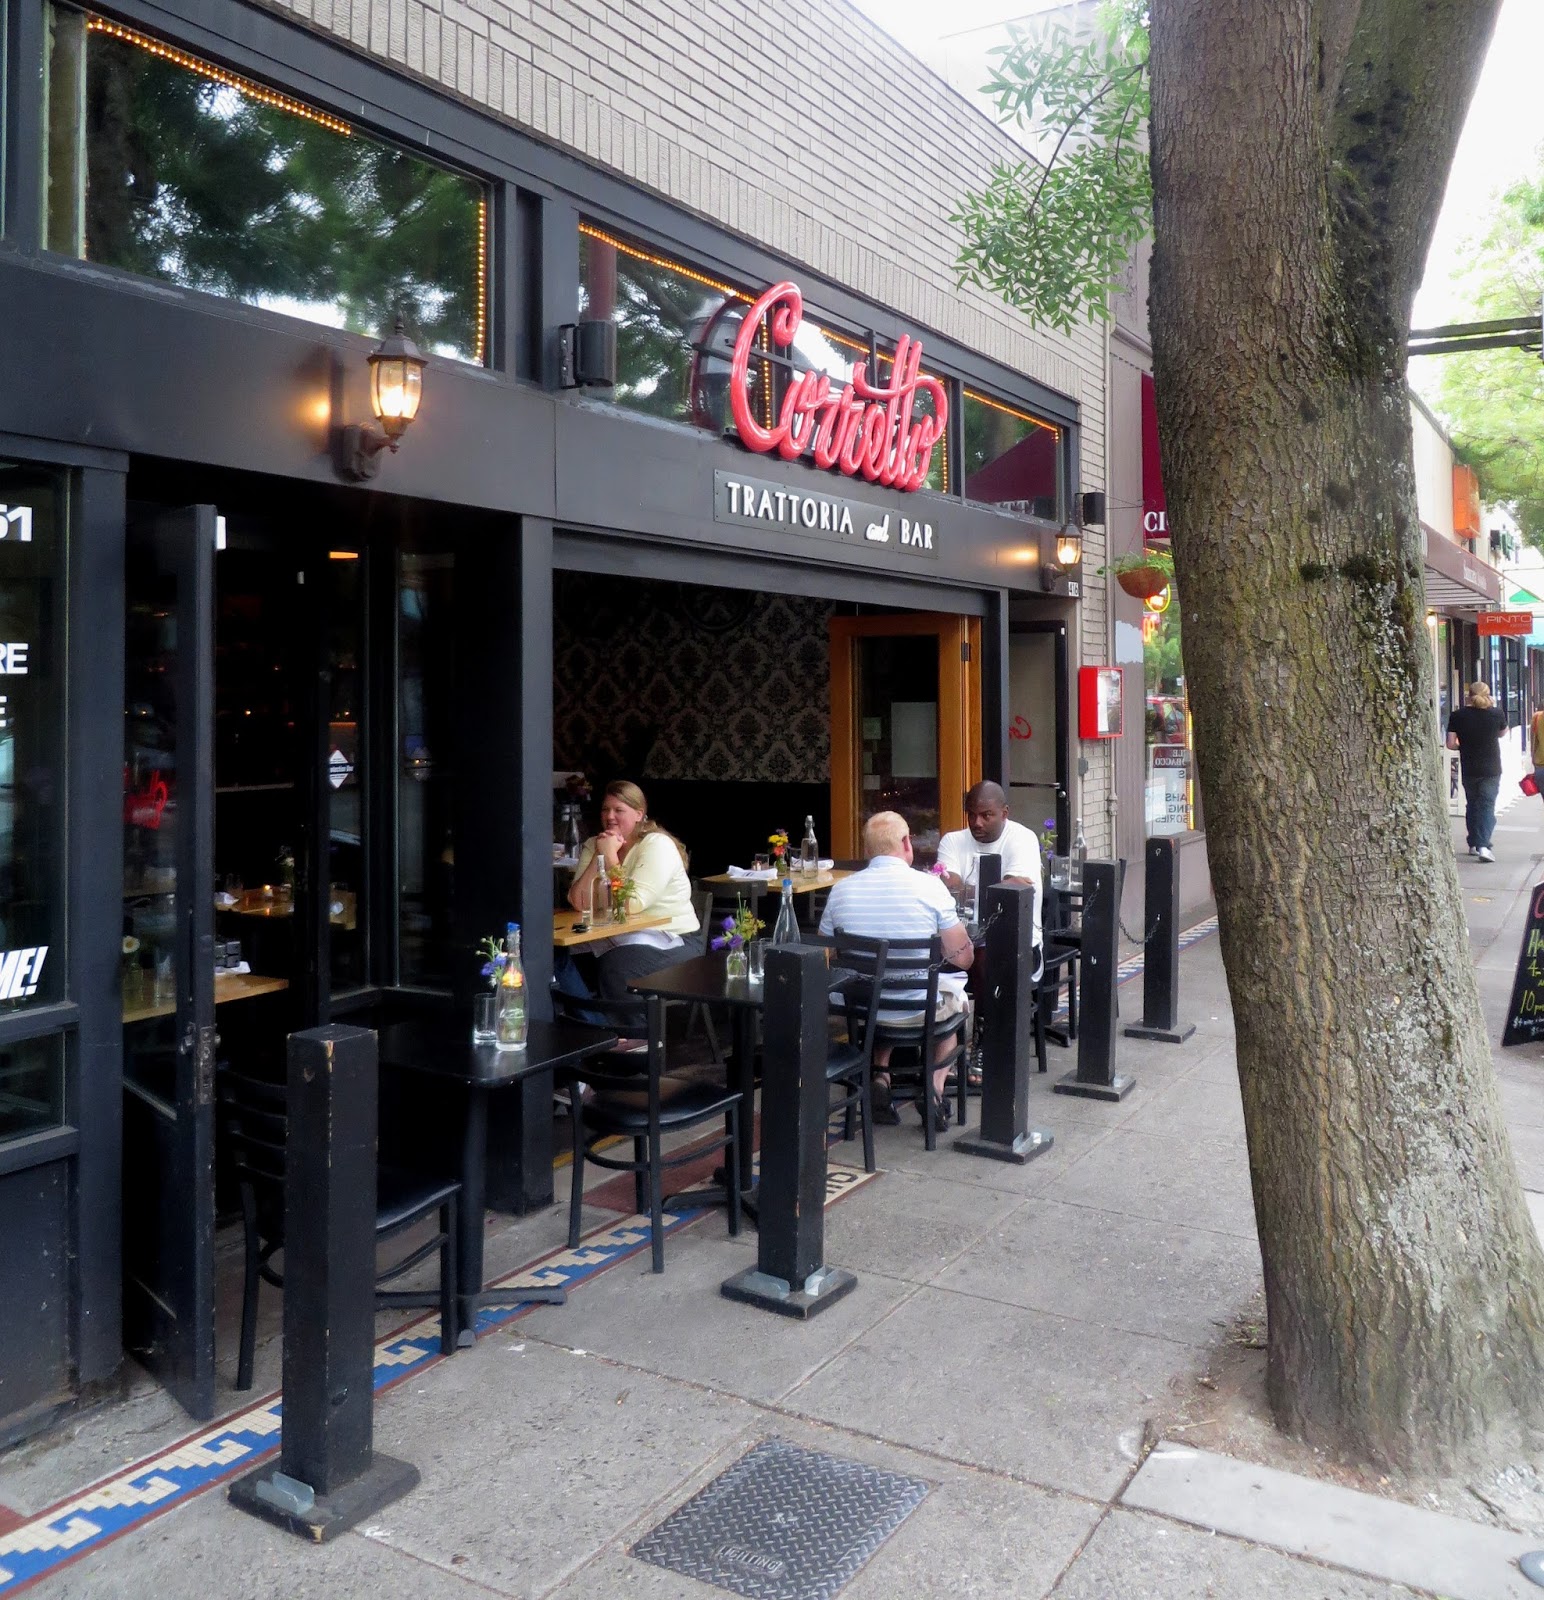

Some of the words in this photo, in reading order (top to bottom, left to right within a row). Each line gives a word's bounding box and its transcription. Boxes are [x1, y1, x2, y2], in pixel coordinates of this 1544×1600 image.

[731, 281, 948, 492] Corretto
[727, 482, 854, 534] TRATTORIA
[864, 514, 890, 544] and
[900, 518, 933, 550] BAR
[1143, 511, 1169, 532] CI
[1487, 615, 1532, 623] PINTO
[715, 1546, 783, 1571] LIGHTING
